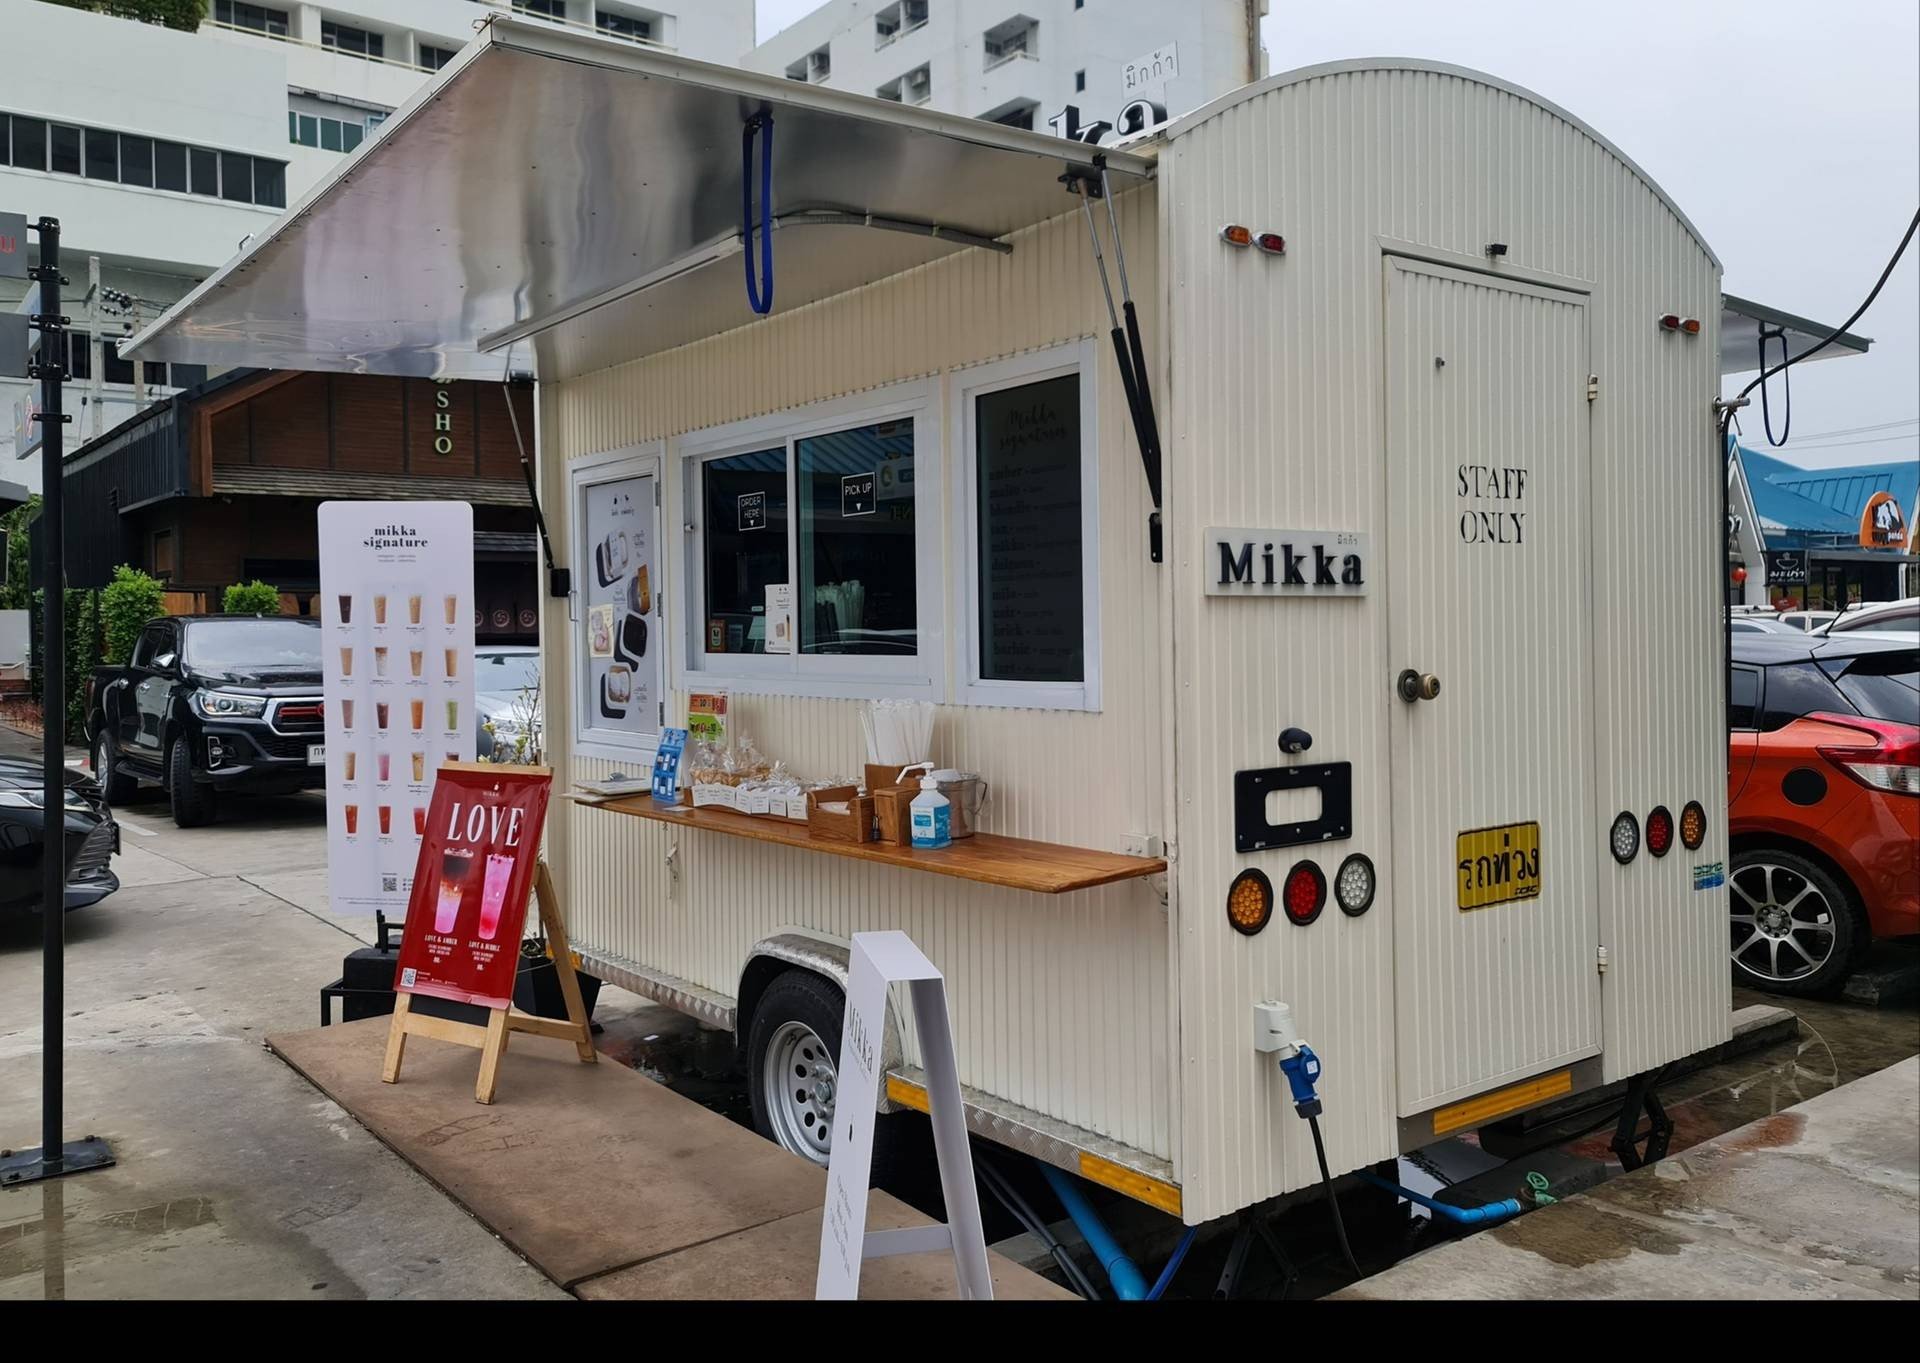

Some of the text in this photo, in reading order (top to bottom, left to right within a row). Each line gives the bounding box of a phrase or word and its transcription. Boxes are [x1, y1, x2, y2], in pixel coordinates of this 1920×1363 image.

[844, 481, 872, 496] PICK UP
[1458, 464, 1528, 500] STAFF
[374, 525, 416, 536] mikka
[1460, 510, 1527, 543] ONLY
[363, 537, 428, 550] signature
[1217, 542, 1364, 585] Mikka
[447, 803, 524, 847] LOVE
